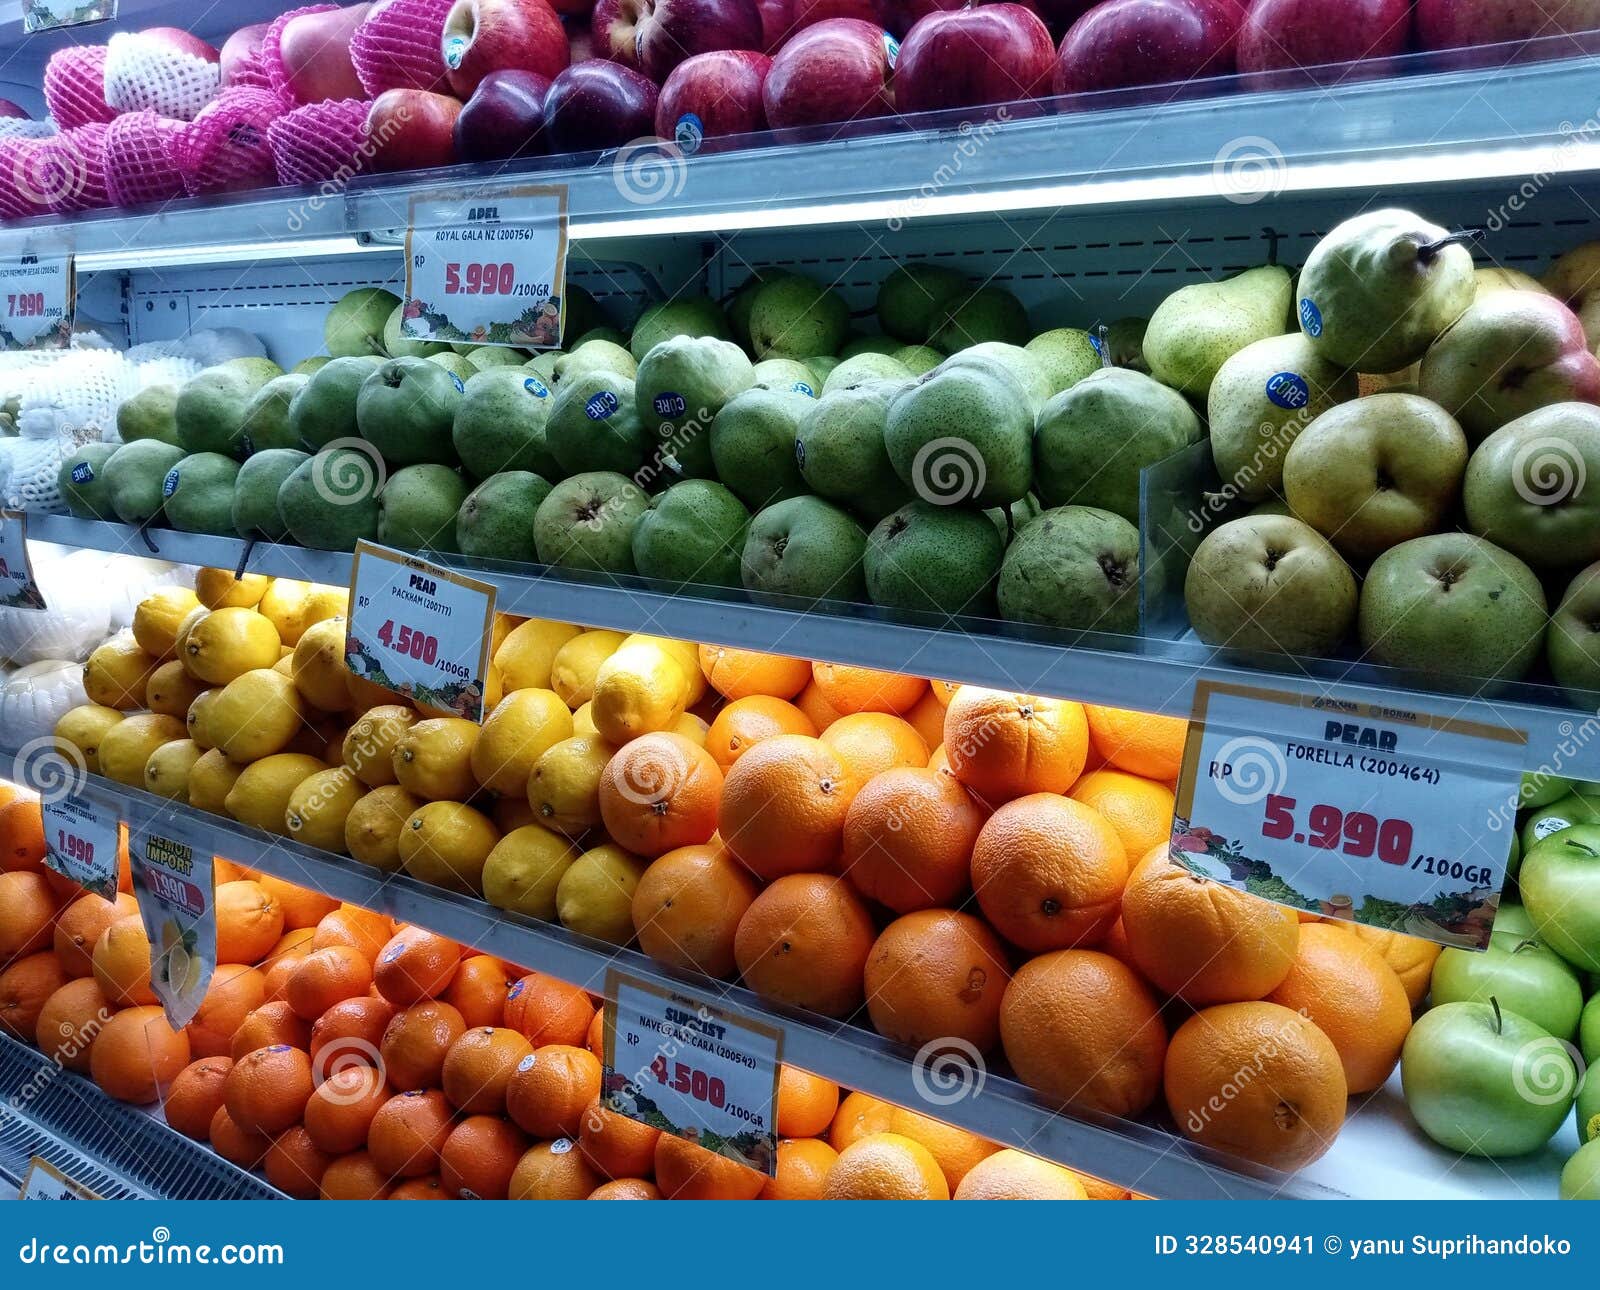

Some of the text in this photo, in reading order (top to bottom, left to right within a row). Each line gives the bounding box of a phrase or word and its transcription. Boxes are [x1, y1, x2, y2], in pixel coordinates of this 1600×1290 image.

[468, 207, 500, 221] APEL
[436, 229, 533, 241] ROYAL GALA NZ (200756)
[414, 255, 425, 267] RP
[445, 263, 549, 297] 5.990 /100GR
[8, 292, 43, 317] 7.990
[1301, 300, 1321, 336] CORE
[1269, 376, 1306, 406] CORE
[587, 392, 616, 418] CORE
[655, 397, 685, 413] CORE
[73, 463, 93, 482] ORE
[392, 586, 423, 606] PACKHAM
[409, 574, 437, 596] PEAR
[359, 596, 370, 608] RP
[377, 619, 470, 679] 4.500 /100GR
[1325, 721, 1398, 752] PEAR
[1209, 761, 1233, 780] RP
[1287, 744, 1441, 785] FORELLA (200464)
[58, 829, 94, 865] 1.990
[1262, 794, 1492, 886] 5.990 /100GR
[146, 843, 193, 876] IMPORT
[627, 1032, 639, 1046] RP
[691, 1036, 714, 1053] CARA
[716, 1046, 757, 1070] (200542)
[650, 1055, 763, 1127] 4.500 /100GR
